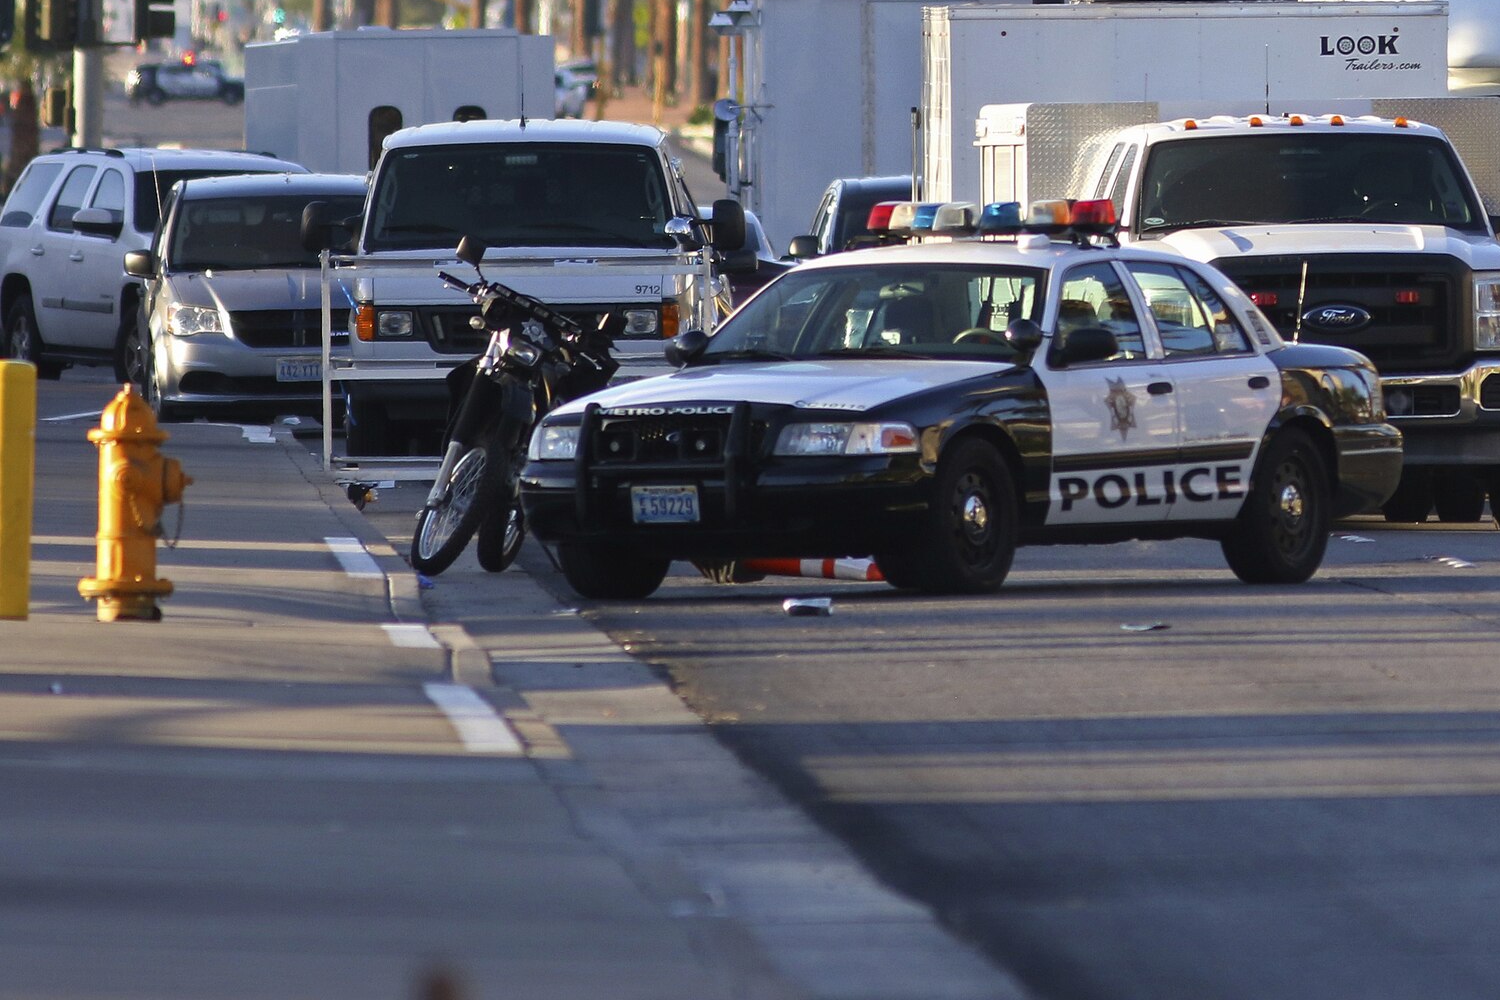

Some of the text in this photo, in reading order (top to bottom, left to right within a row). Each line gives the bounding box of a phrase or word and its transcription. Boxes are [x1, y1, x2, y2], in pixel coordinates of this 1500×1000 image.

[1319, 35, 1400, 56] LOOK
[1344, 58, 1422, 71] Trailers.com
[635, 285, 661, 296] 9712
[1320, 308, 1356, 324] Ford
[594, 405, 735, 416] METRO POLICE
[1058, 464, 1245, 512] POLICE
[650, 495, 694, 516] 59229
